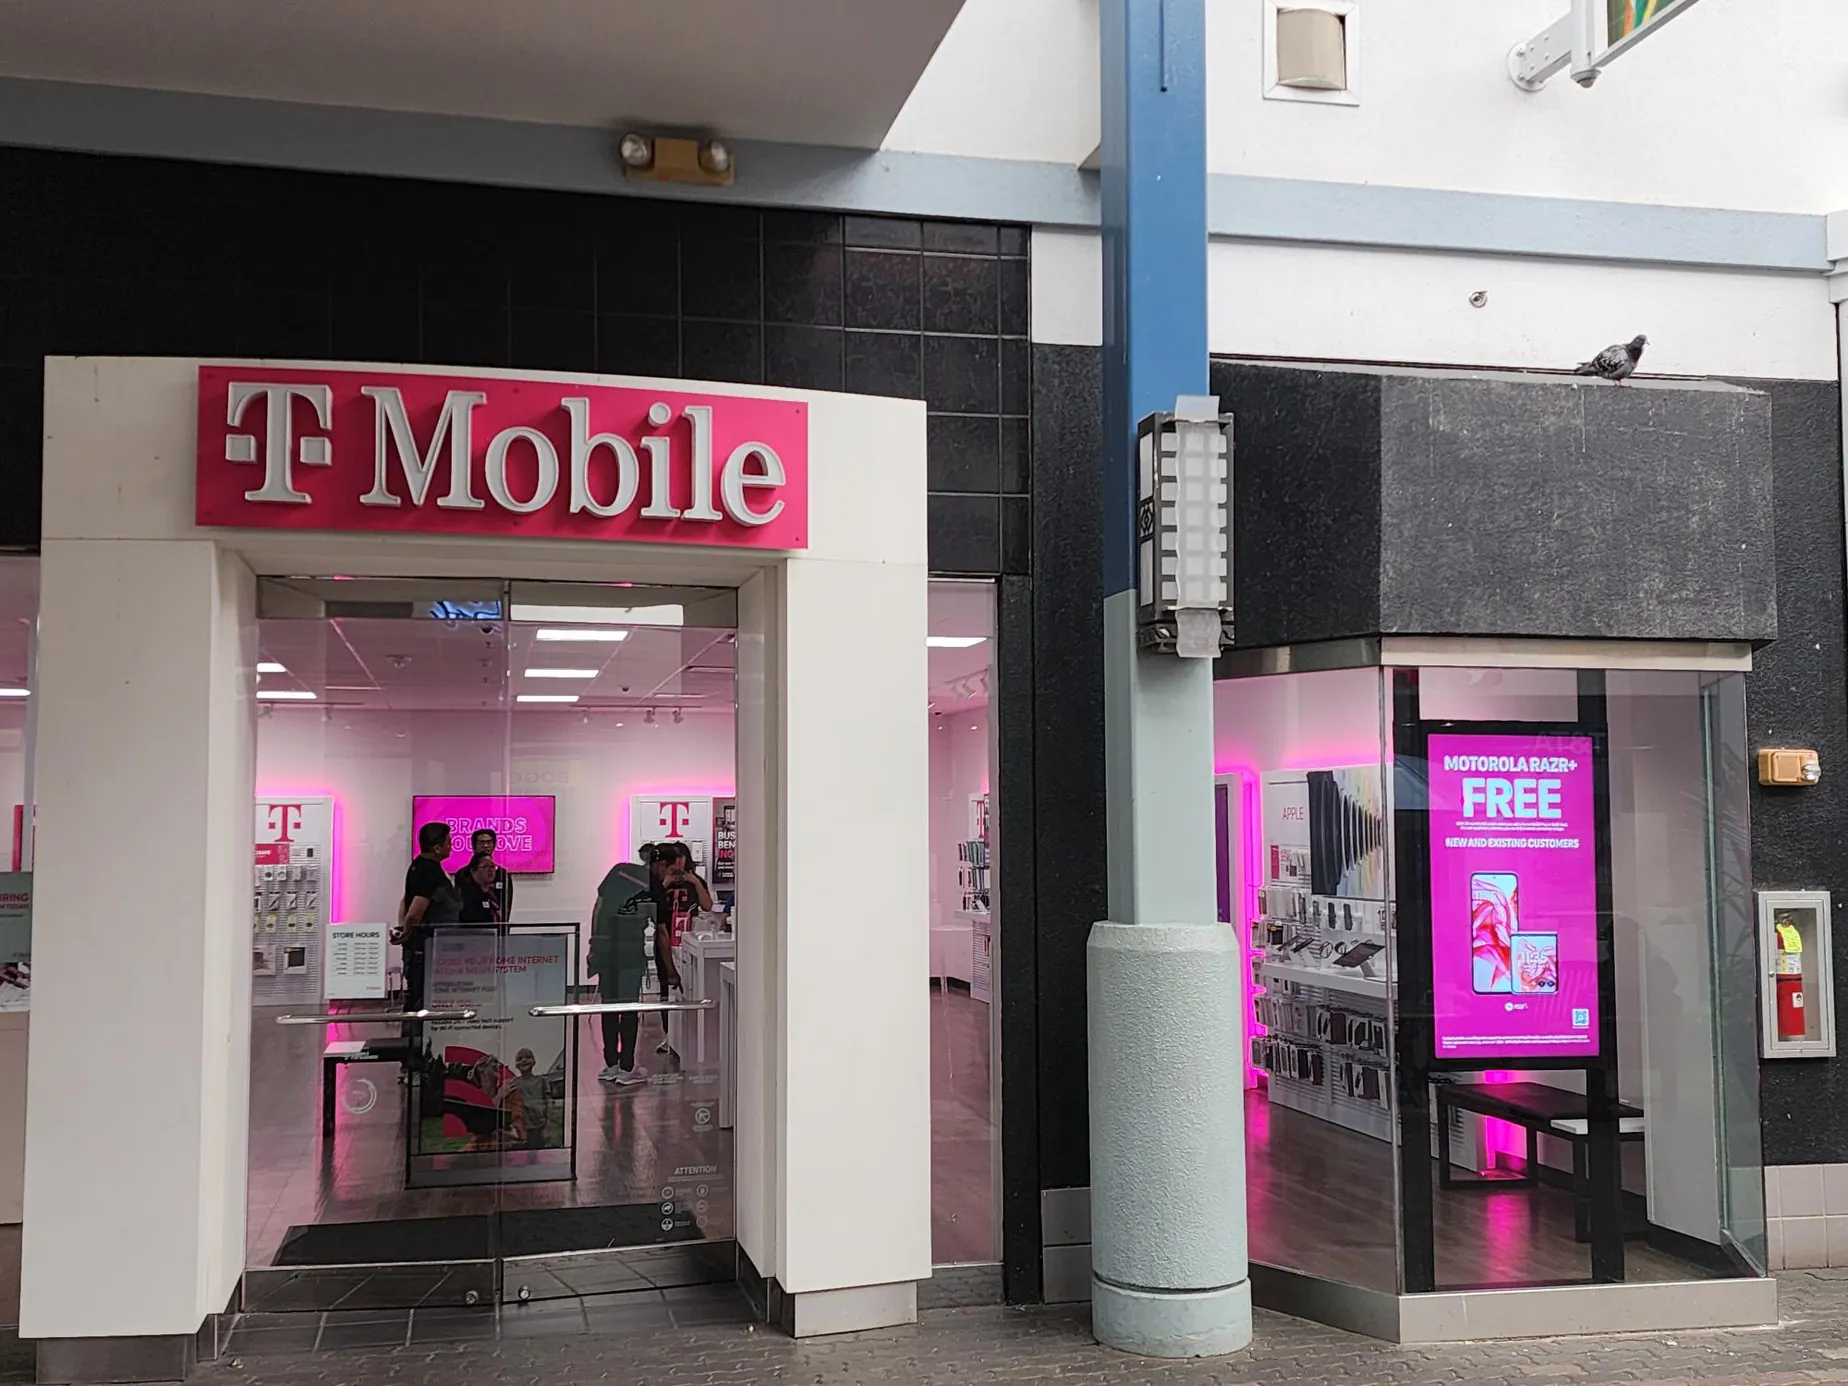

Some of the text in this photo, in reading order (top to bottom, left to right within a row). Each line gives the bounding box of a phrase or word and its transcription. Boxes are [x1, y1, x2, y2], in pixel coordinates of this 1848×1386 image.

[360, 386, 786, 527] Mobile
[1443, 755, 1578, 773] MOTOROLA RAZR+
[1462, 777, 1562, 819] FREE
[1282, 806, 1305, 821] APPLE
[446, 817, 527, 834] BRANDS
[495, 835, 533, 852] OVE
[1445, 837, 1580, 850] NEW AND EXISTING CUSTOMERS
[332, 931, 380, 939] STORE HOURS
[517, 955, 559, 964] INTERNET
[674, 1165, 717, 1176] ATTENTION
